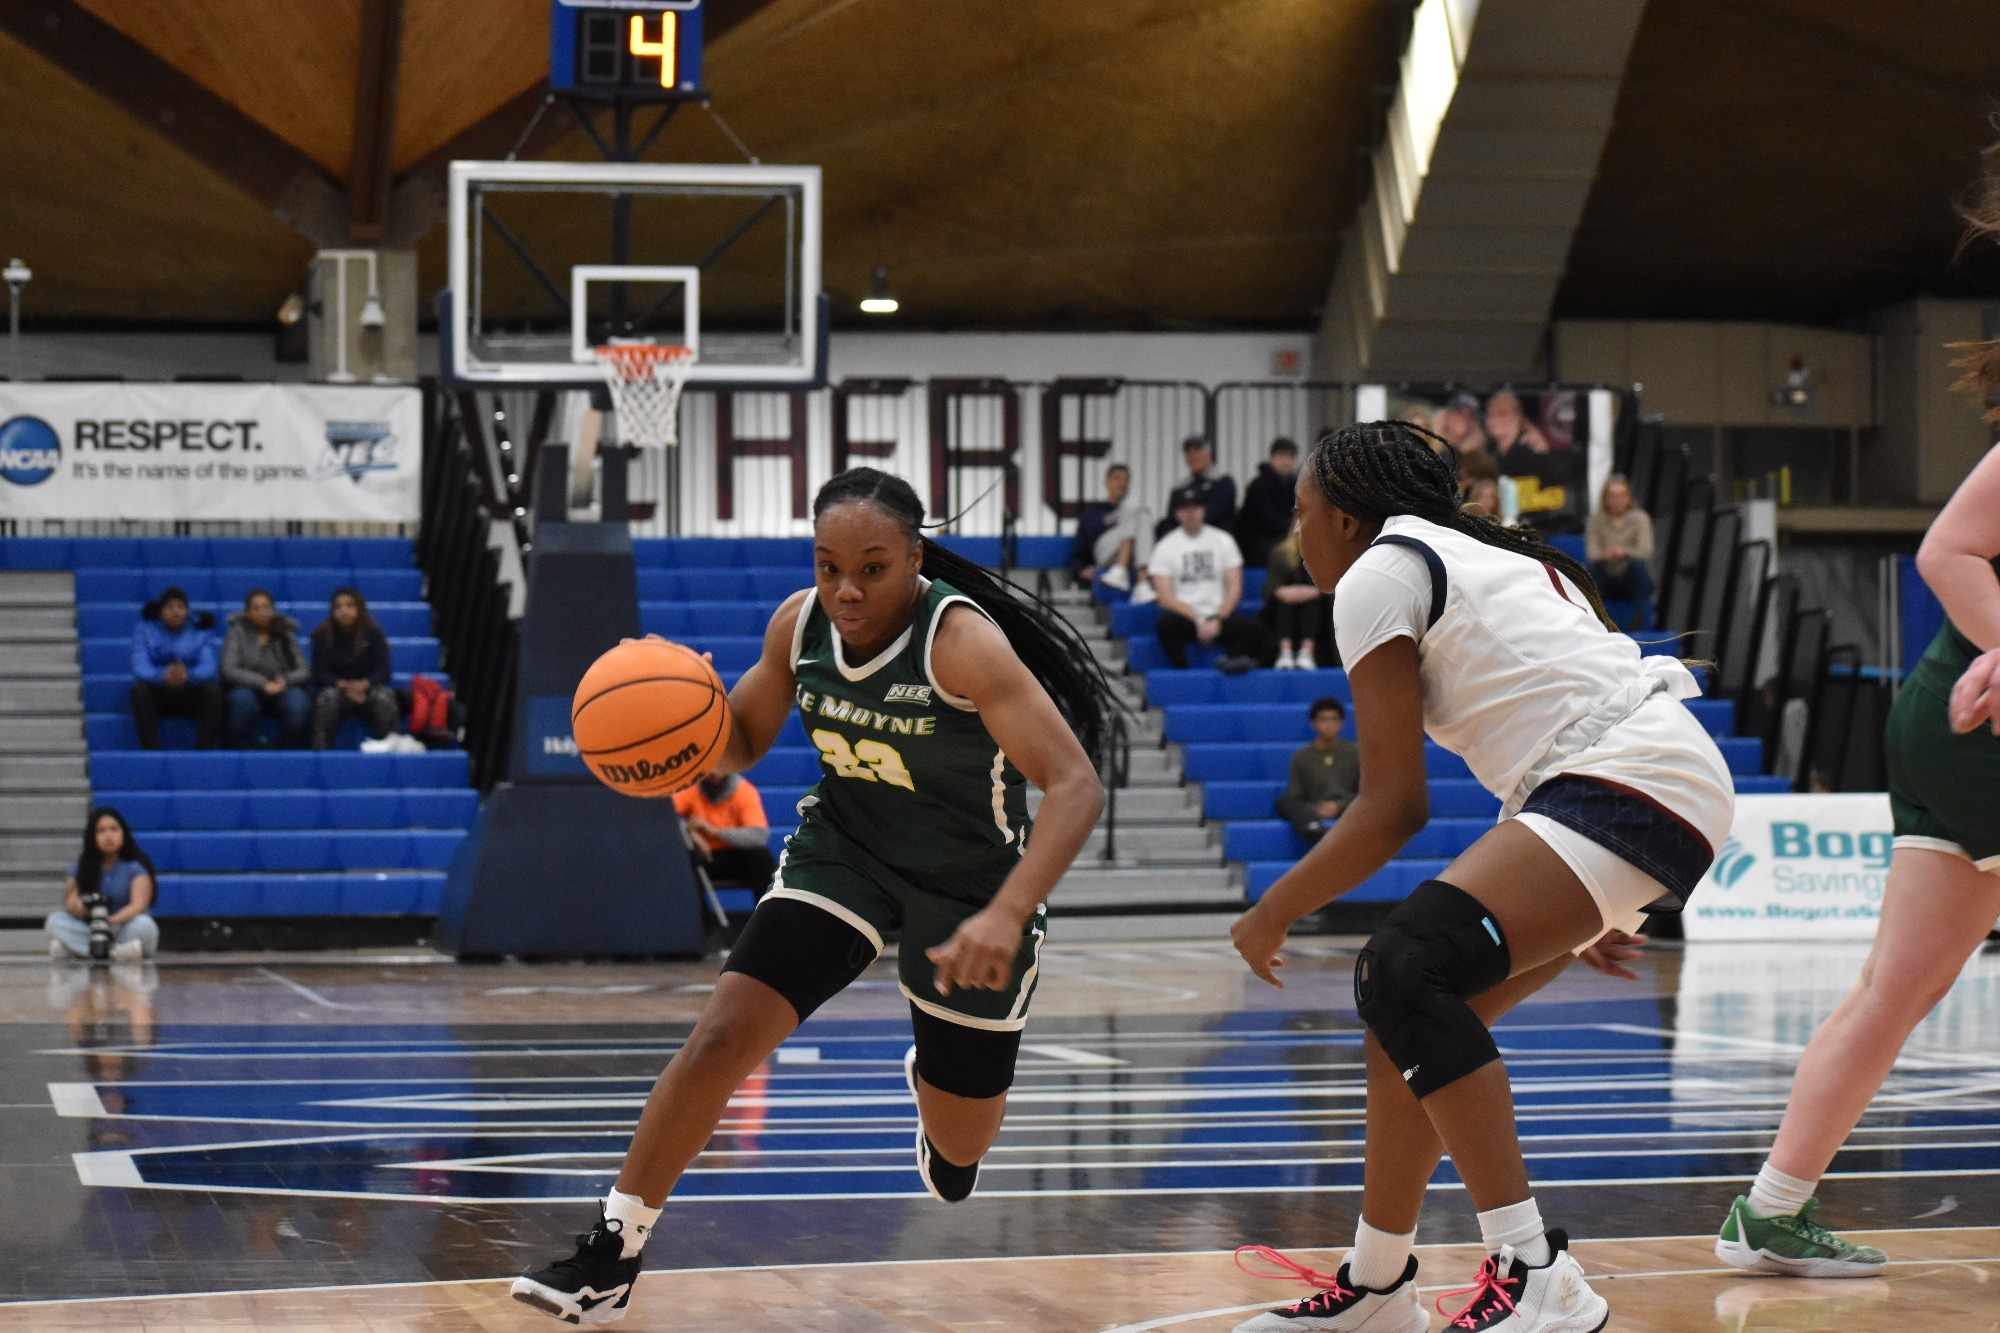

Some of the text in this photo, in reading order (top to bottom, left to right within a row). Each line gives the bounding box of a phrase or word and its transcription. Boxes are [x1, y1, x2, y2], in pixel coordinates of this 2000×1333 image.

[630, 11, 676, 88] 4
[74, 420, 264, 452] RESPECT.
[0, 447, 61, 471] NCAA
[72, 461, 311, 482] It's the name of the game.
[887, 684, 931, 700] NEC
[818, 693, 937, 736] MOYNE
[598, 742, 700, 783] Wilson
[1772, 865, 1886, 899] Saving
